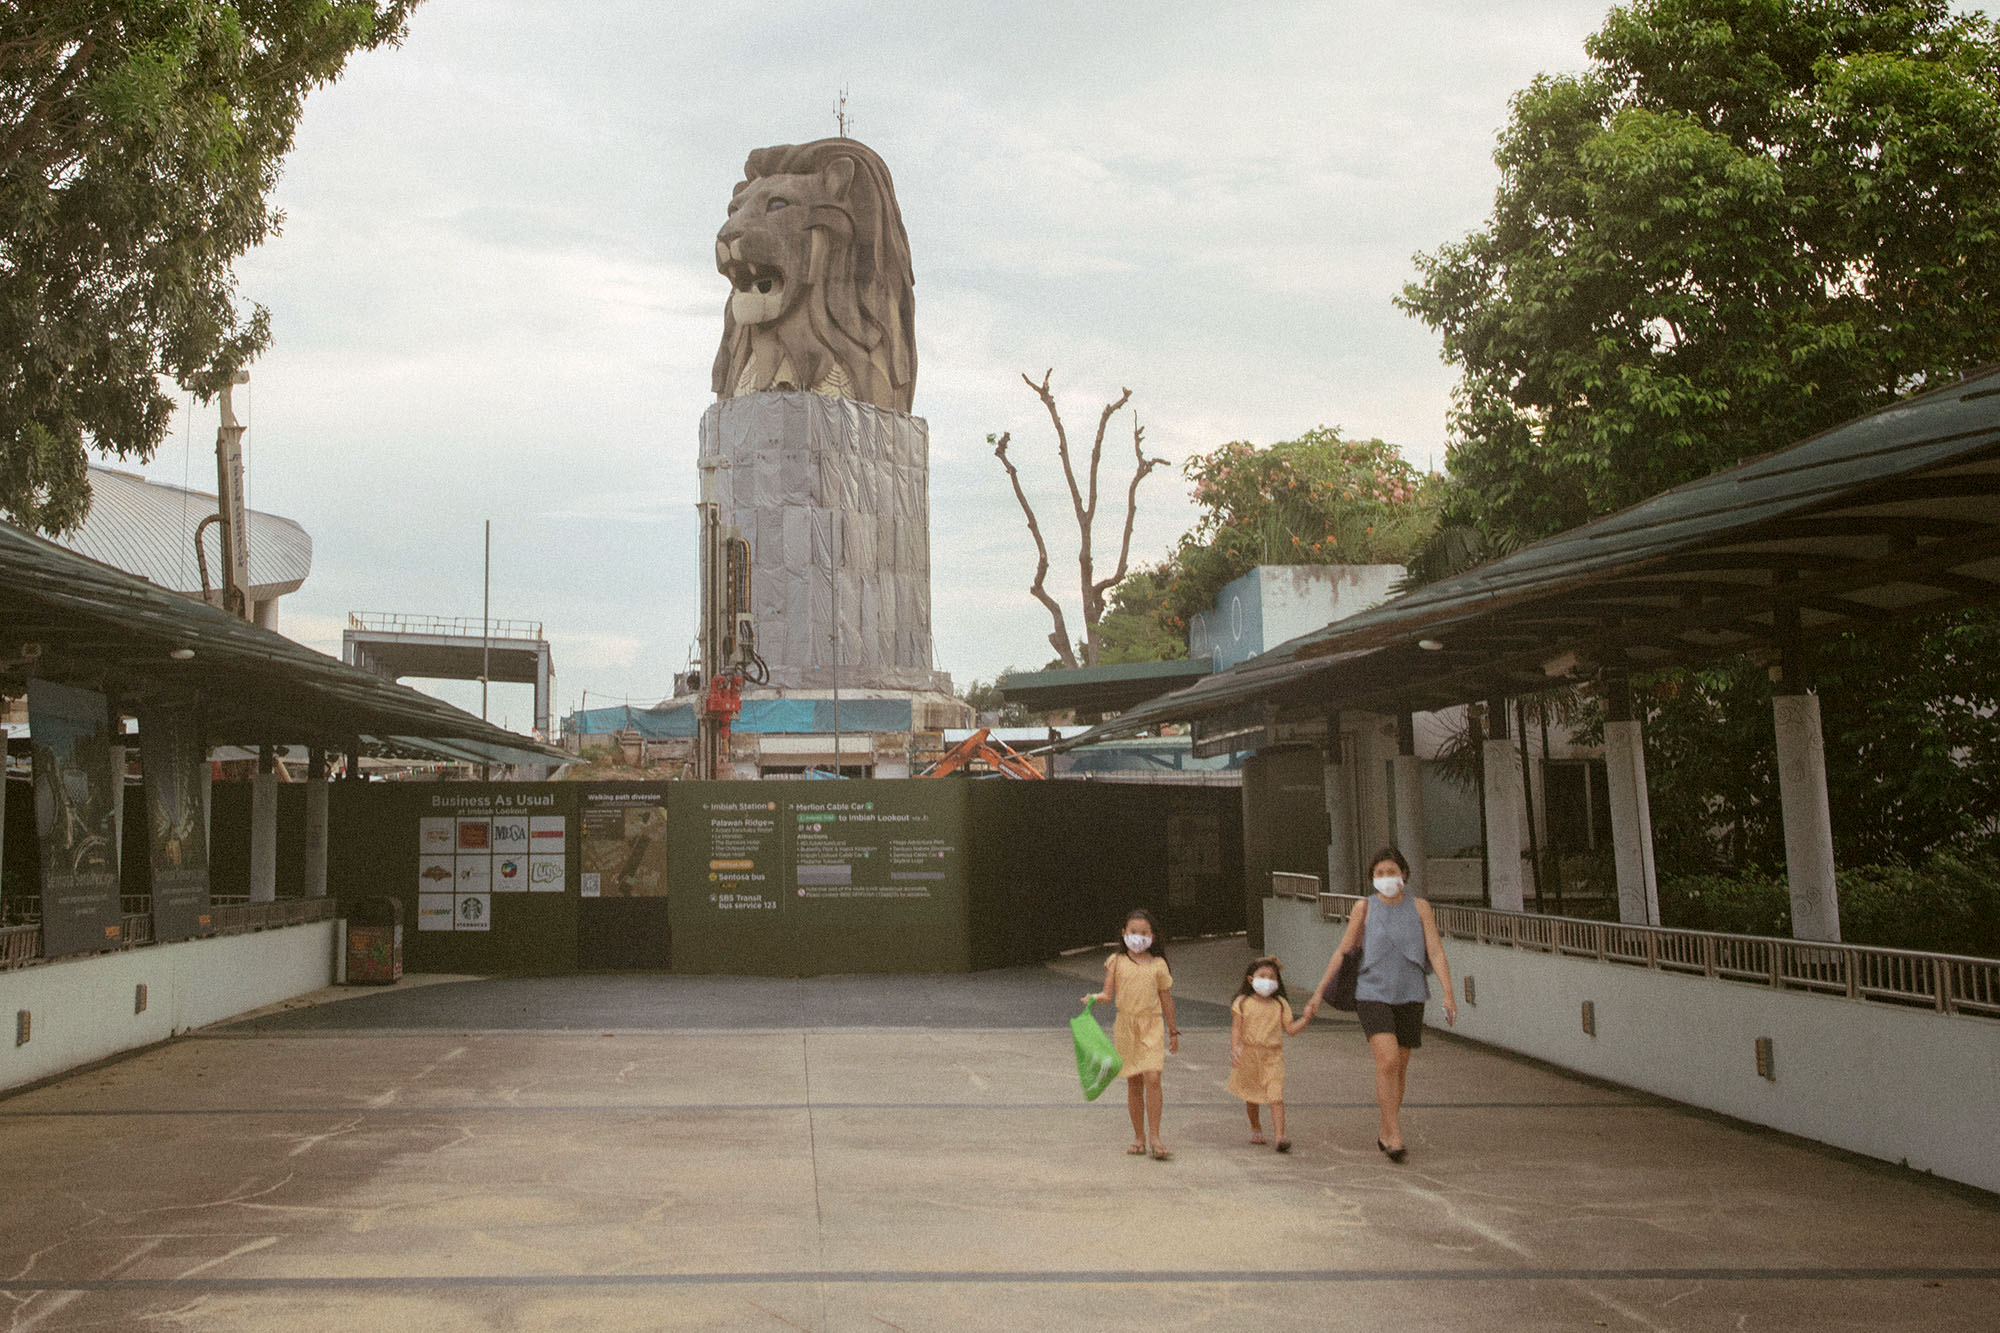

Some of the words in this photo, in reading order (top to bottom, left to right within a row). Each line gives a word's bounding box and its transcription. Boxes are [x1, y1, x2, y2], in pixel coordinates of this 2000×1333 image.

[431, 794, 491, 807] Business
[495, 794, 513, 806] As
[516, 793, 555, 806] Usual
[711, 803, 738, 811] Imbiah
[796, 803, 825, 811] Merlion
[827, 802, 849, 811] Cable
[851, 803, 865, 811] Car
[495, 807, 528, 815] Lookout
[711, 819, 743, 827] Palawan
[744, 819, 767, 828] Ridge
[718, 873, 750, 881] Sentosa
[751, 873, 766, 881] bus
[763, 901, 777, 909] 123
